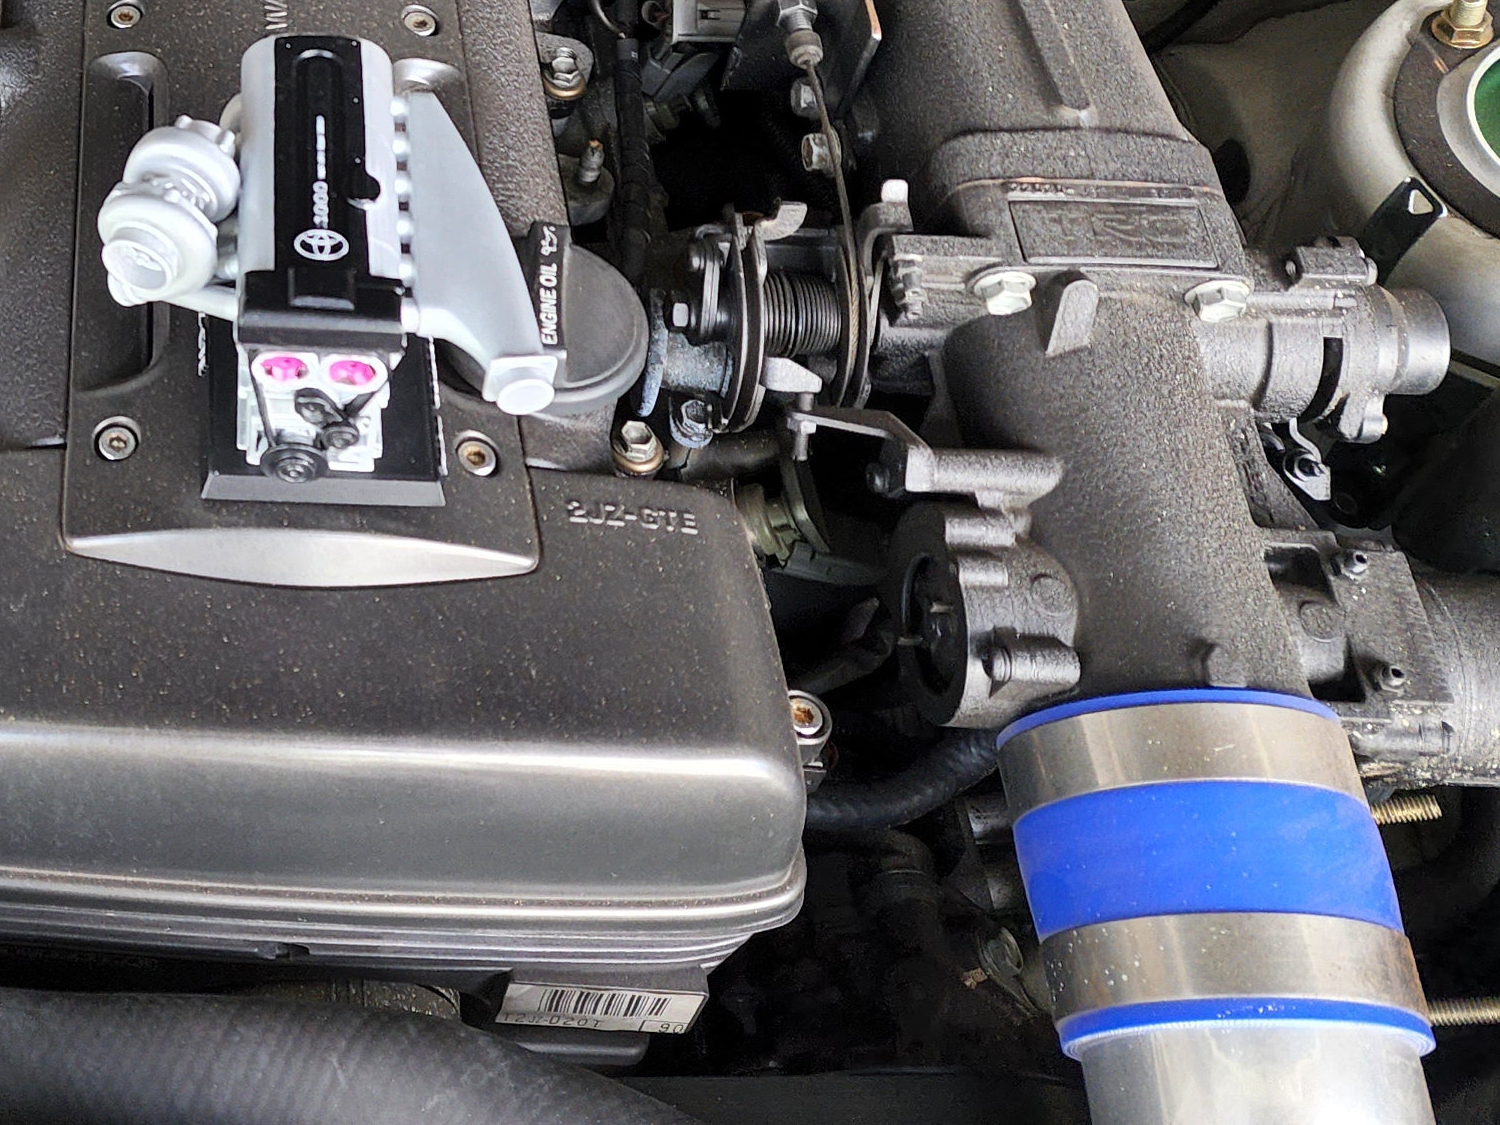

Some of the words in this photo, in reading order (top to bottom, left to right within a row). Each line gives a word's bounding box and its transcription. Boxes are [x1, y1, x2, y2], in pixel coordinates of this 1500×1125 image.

[538, 262, 560, 288] OIL
[538, 288, 560, 346] ENGINE
[566, 499, 700, 536] 2JZ-GTE
